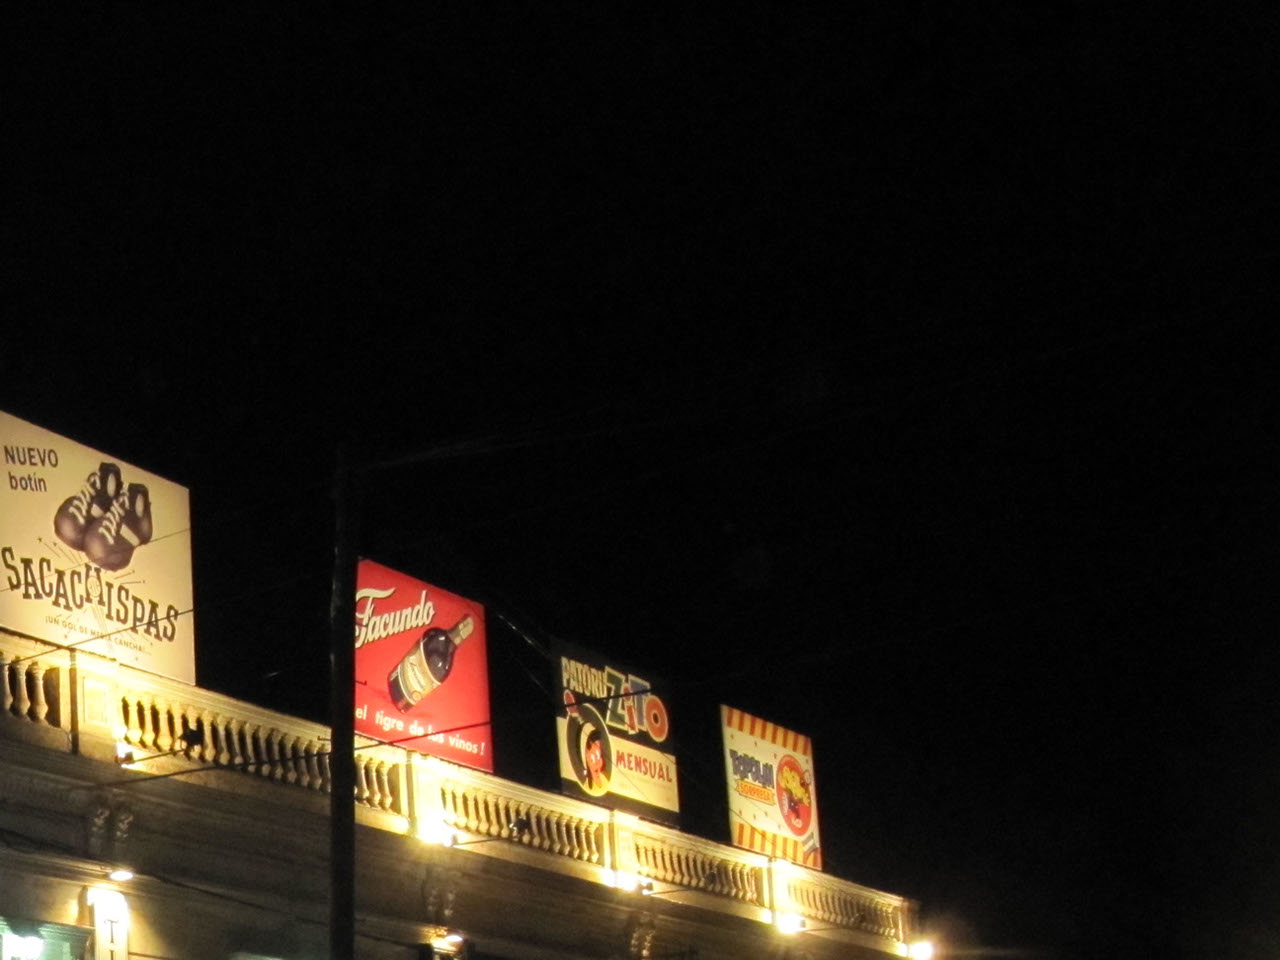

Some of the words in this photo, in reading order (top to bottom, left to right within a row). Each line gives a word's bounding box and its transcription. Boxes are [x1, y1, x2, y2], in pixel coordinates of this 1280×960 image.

[3, 445, 59, 468] NUEVO
[1, 547, 179, 642] SACACHISPAS
[355, 587, 436, 649] Facundo
[355, 705, 368, 720] el
[375, 710, 404, 731] tigre
[409, 720, 425, 736] de
[615, 749, 673, 783] MENSUAL
